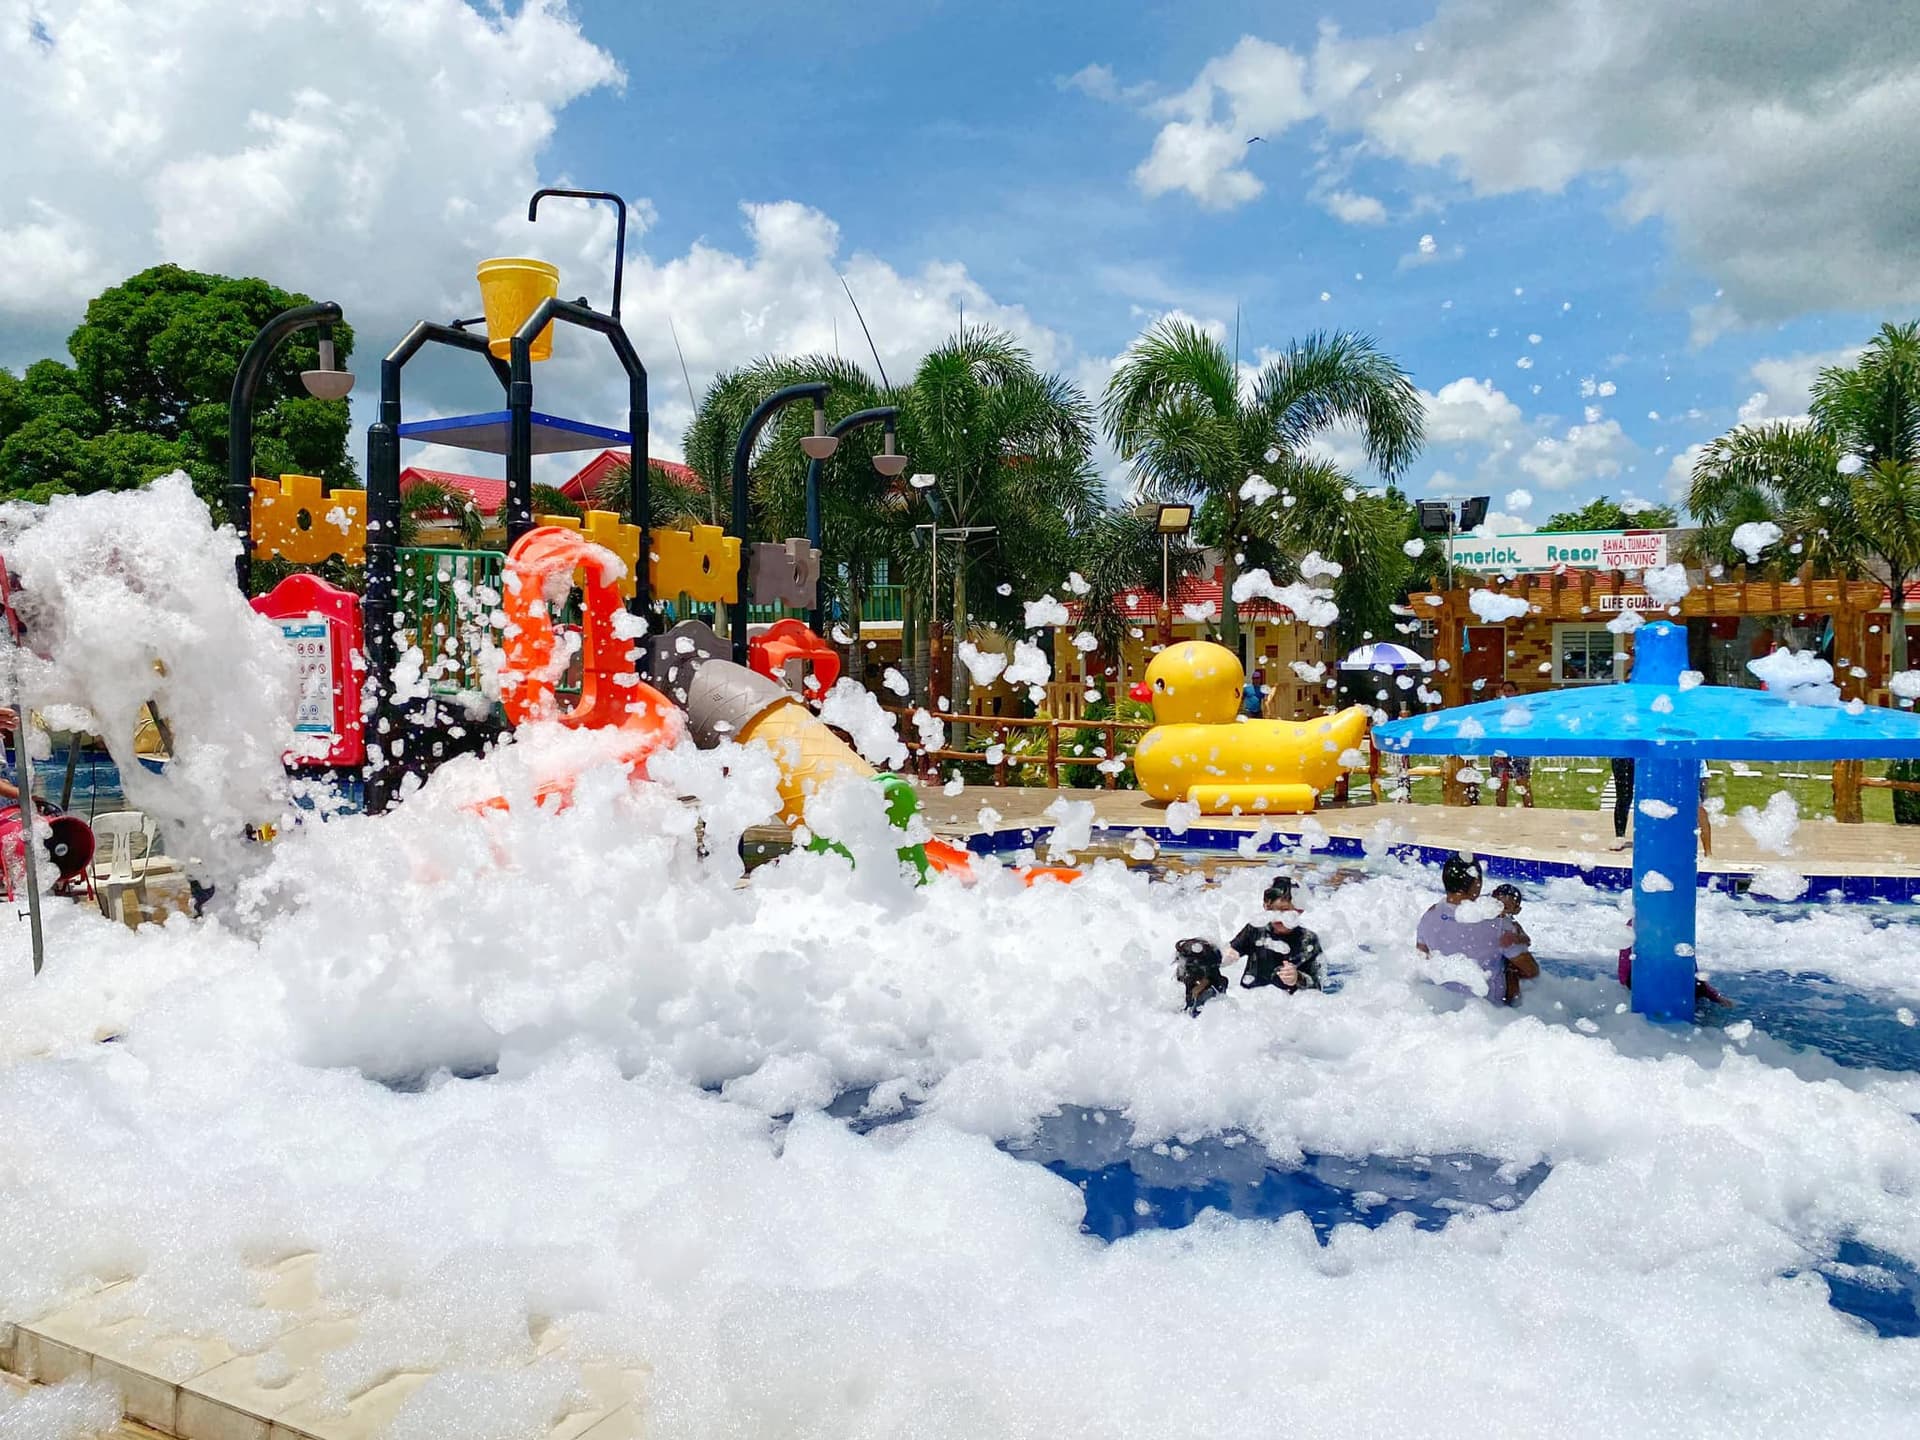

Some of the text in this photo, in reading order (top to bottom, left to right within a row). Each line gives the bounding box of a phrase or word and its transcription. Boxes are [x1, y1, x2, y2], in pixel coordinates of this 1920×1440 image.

[1603, 536, 1661, 551] BAWAL TUMALON
[1607, 554, 1621, 566] NO
[1602, 597, 1624, 609] LIFE
